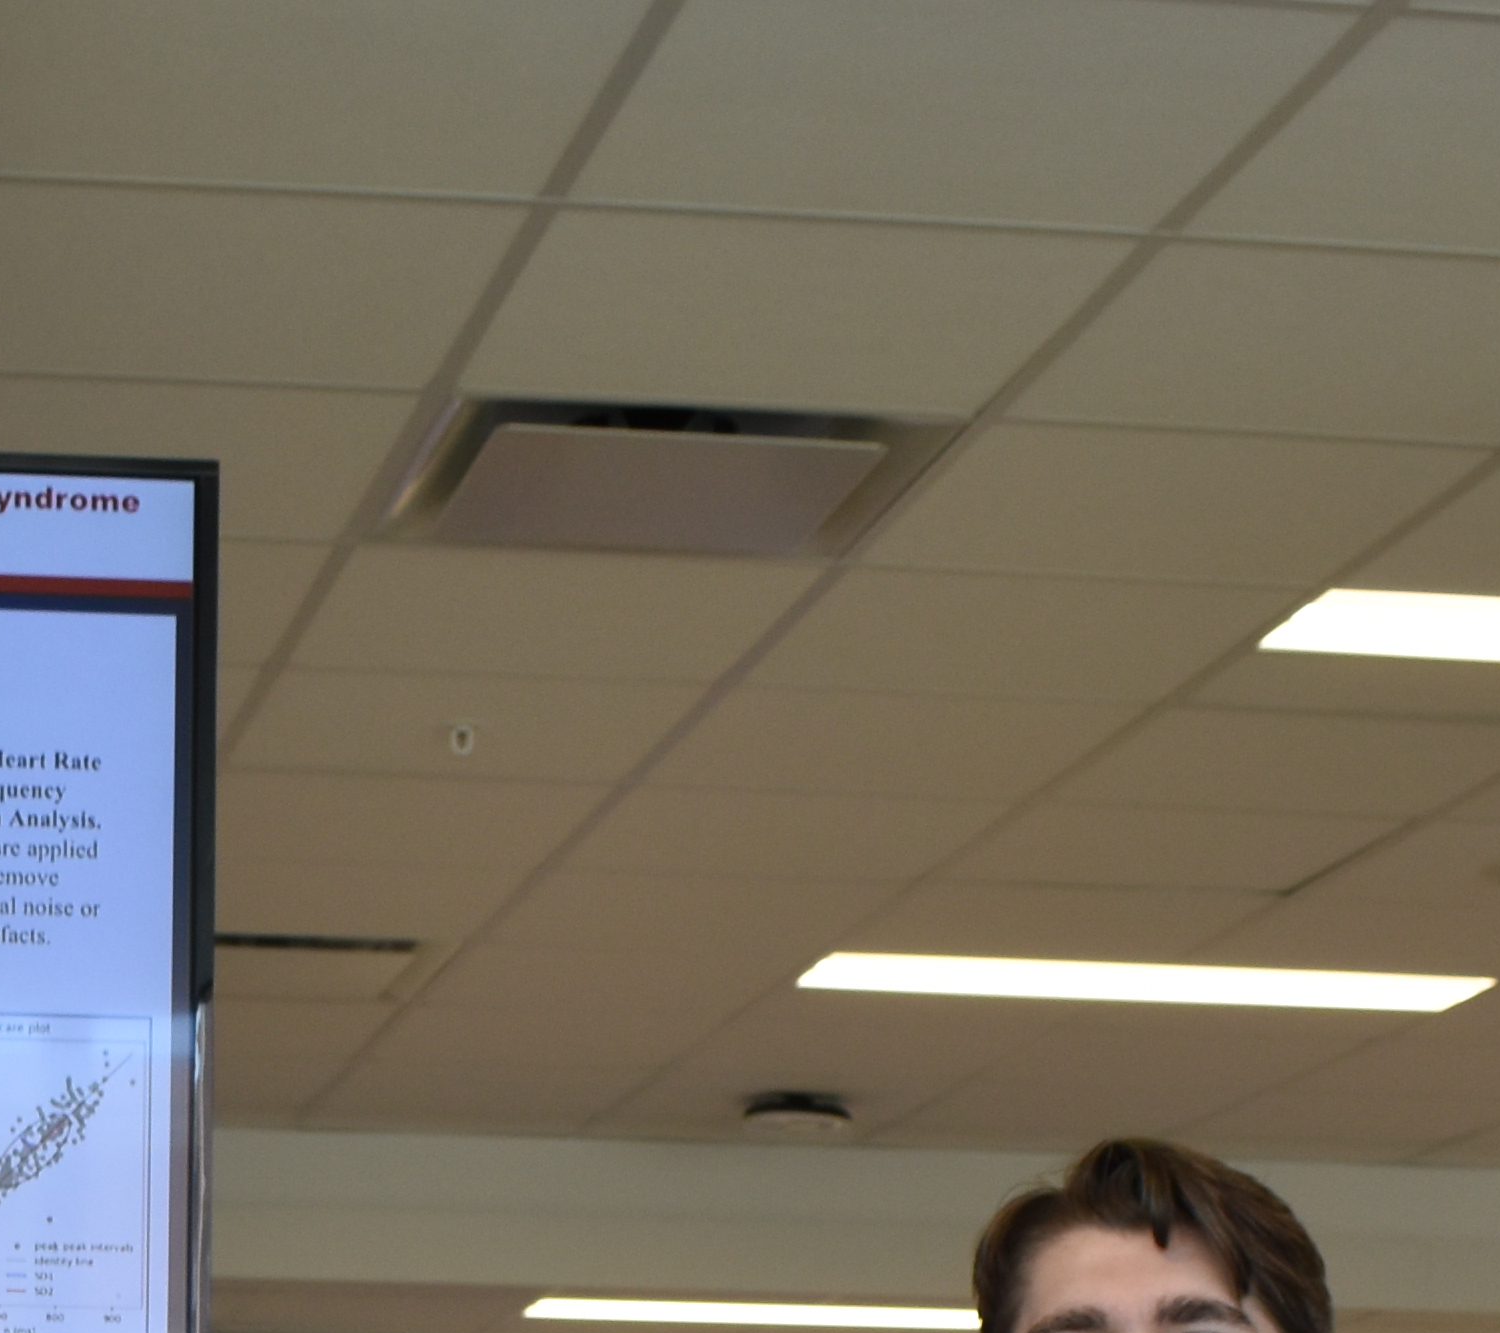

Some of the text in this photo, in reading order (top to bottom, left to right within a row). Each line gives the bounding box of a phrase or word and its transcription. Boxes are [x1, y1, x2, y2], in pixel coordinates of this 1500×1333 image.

[54, 751, 101, 771] Rate
[9, 809, 101, 833] Analysis.
[27, 838, 97, 863] applied
[23, 897, 73, 917] noise
[80, 903, 100, 917] or
